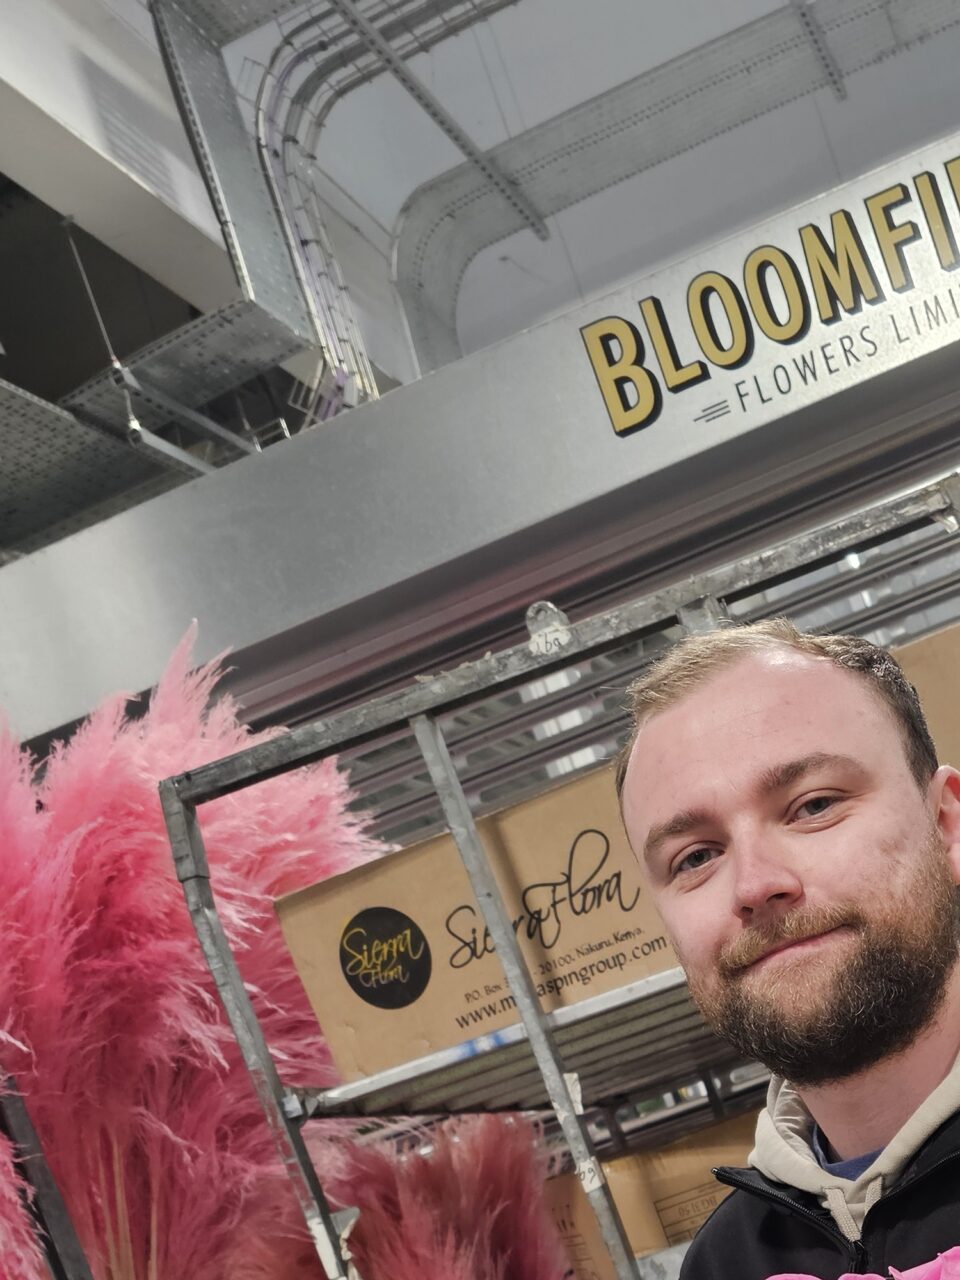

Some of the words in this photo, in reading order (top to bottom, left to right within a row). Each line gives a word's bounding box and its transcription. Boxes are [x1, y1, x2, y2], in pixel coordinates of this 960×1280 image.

[735, 326, 879, 413] FLOWERS
[343, 927, 425, 976] Sierra
[455, 935, 668, 1029] www.maspingroup.com
